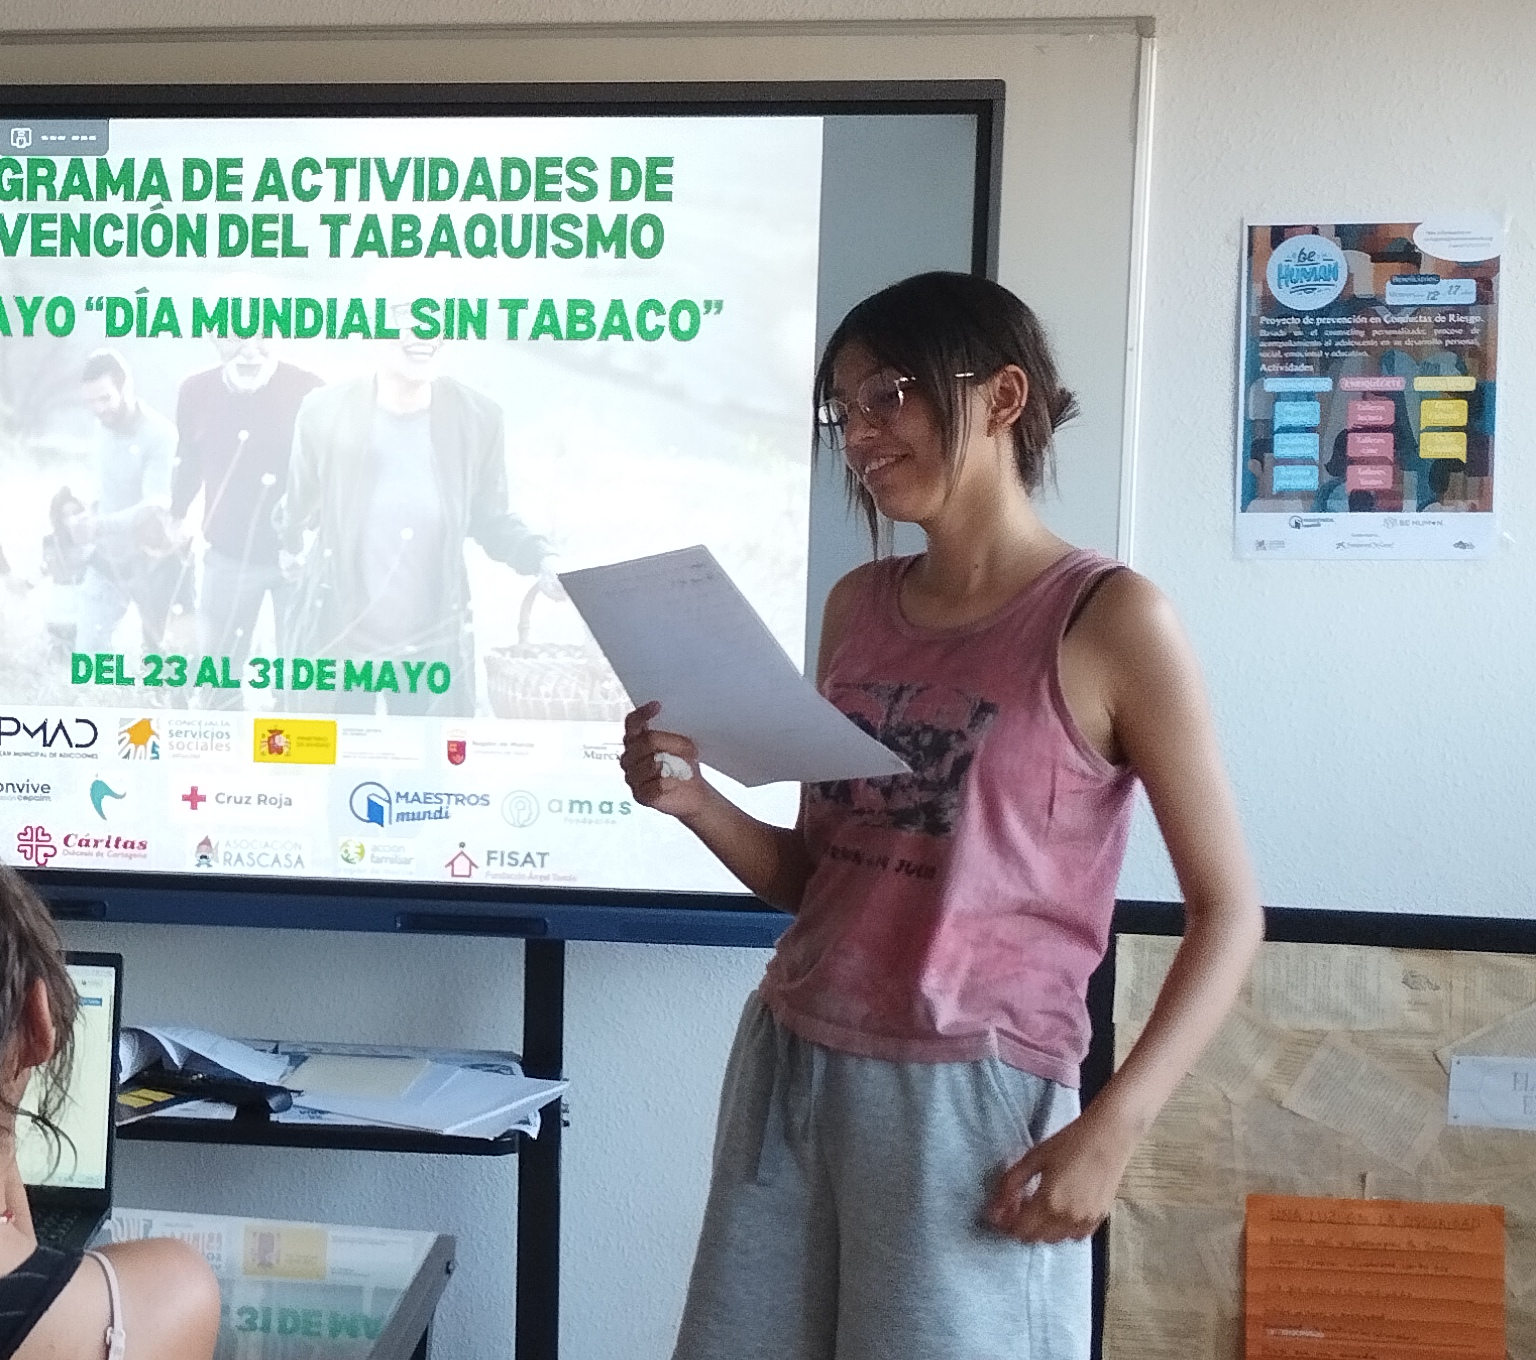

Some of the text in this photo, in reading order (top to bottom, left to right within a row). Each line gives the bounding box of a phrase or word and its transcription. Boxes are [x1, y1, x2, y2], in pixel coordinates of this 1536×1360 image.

[182, 156, 243, 202] DE
[252, 156, 599, 202] ACTIVIDADES
[610, 156, 675, 202] DE
[218, 213, 308, 258] DEL
[319, 213, 665, 259] TABAQUISMO
[1277, 261, 1339, 289] HUMAN
[191, 297, 400, 339] MUNDIAL
[410, 297, 487, 340] SIN
[497, 298, 724, 342] TABACO”
[1260, 316, 1301, 326] Proyecto
[1302, 315, 1314, 324] de
[1316, 315, 1367, 326] prevención
[1434, 314, 1447, 323] de
[71, 652, 452, 695] DEL 23 AL 31 DE MAYO
[167, 726, 231, 741] servicios
[167, 740, 231, 753] sociales
[214, 792, 293, 809] Cruz Roja
[395, 791, 491, 807] MAESTROS
[547, 798, 632, 817] amas
[395, 806, 452, 823] mundi
[63, 832, 148, 852] Cáritas
[223, 851, 306, 870] RASCASA
[486, 849, 550, 869] FISAT
